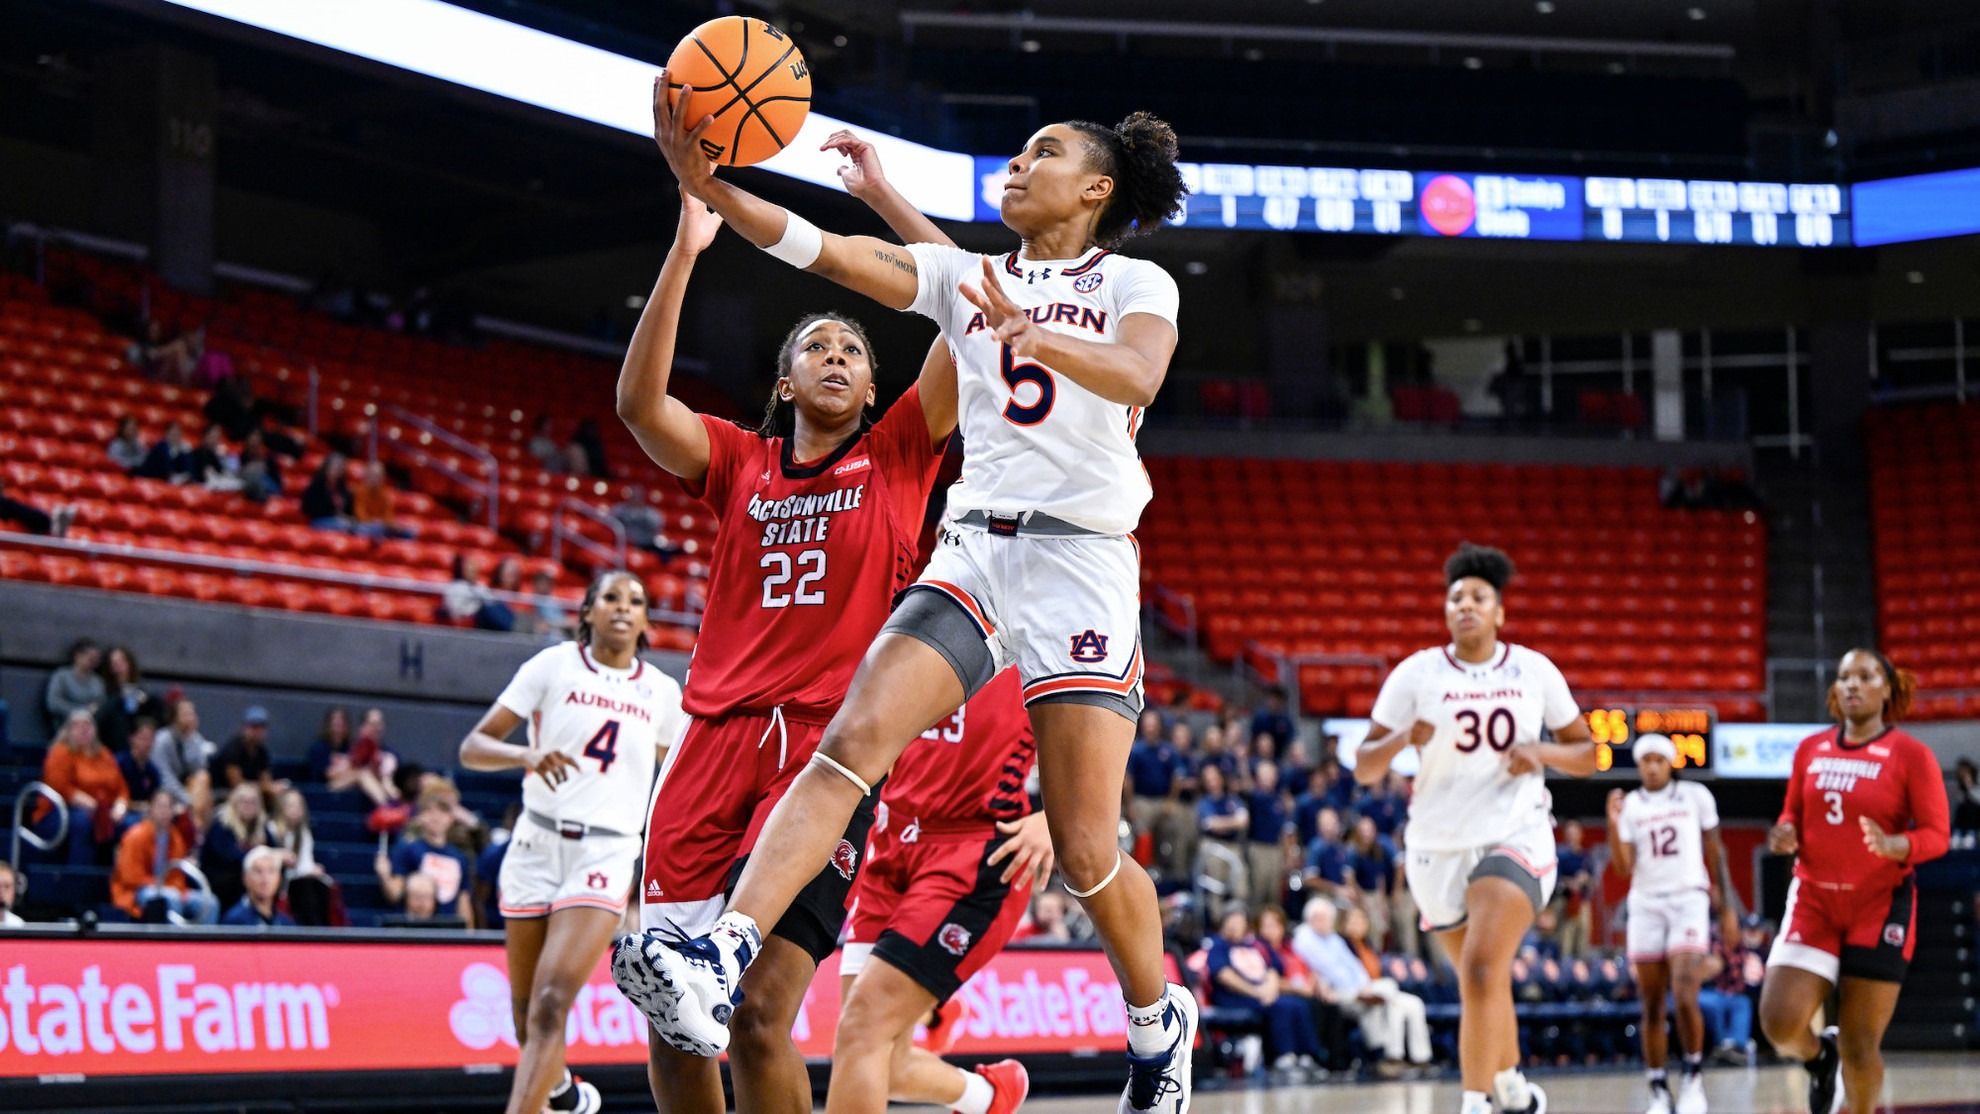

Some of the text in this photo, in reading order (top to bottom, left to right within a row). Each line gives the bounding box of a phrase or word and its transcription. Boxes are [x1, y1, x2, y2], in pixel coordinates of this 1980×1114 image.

[1074, 273, 1103, 292] SEC
[965, 302, 1107, 335] AURN
[1000, 340, 1056, 427] 5
[761, 516, 829, 547] STATE
[759, 548, 827, 608] 22
[399, 640, 424, 682] H
[565, 690, 652, 723] AUBURN
[1442, 689, 1523, 703] AUBURN
[920, 703, 966, 743] 3
[1455, 707, 1516, 752] 30
[583, 718, 621, 774] 4
[1823, 791, 1844, 825] 3
[1650, 825, 1679, 858] 12
[0, 963, 330, 1055] tateFarm
